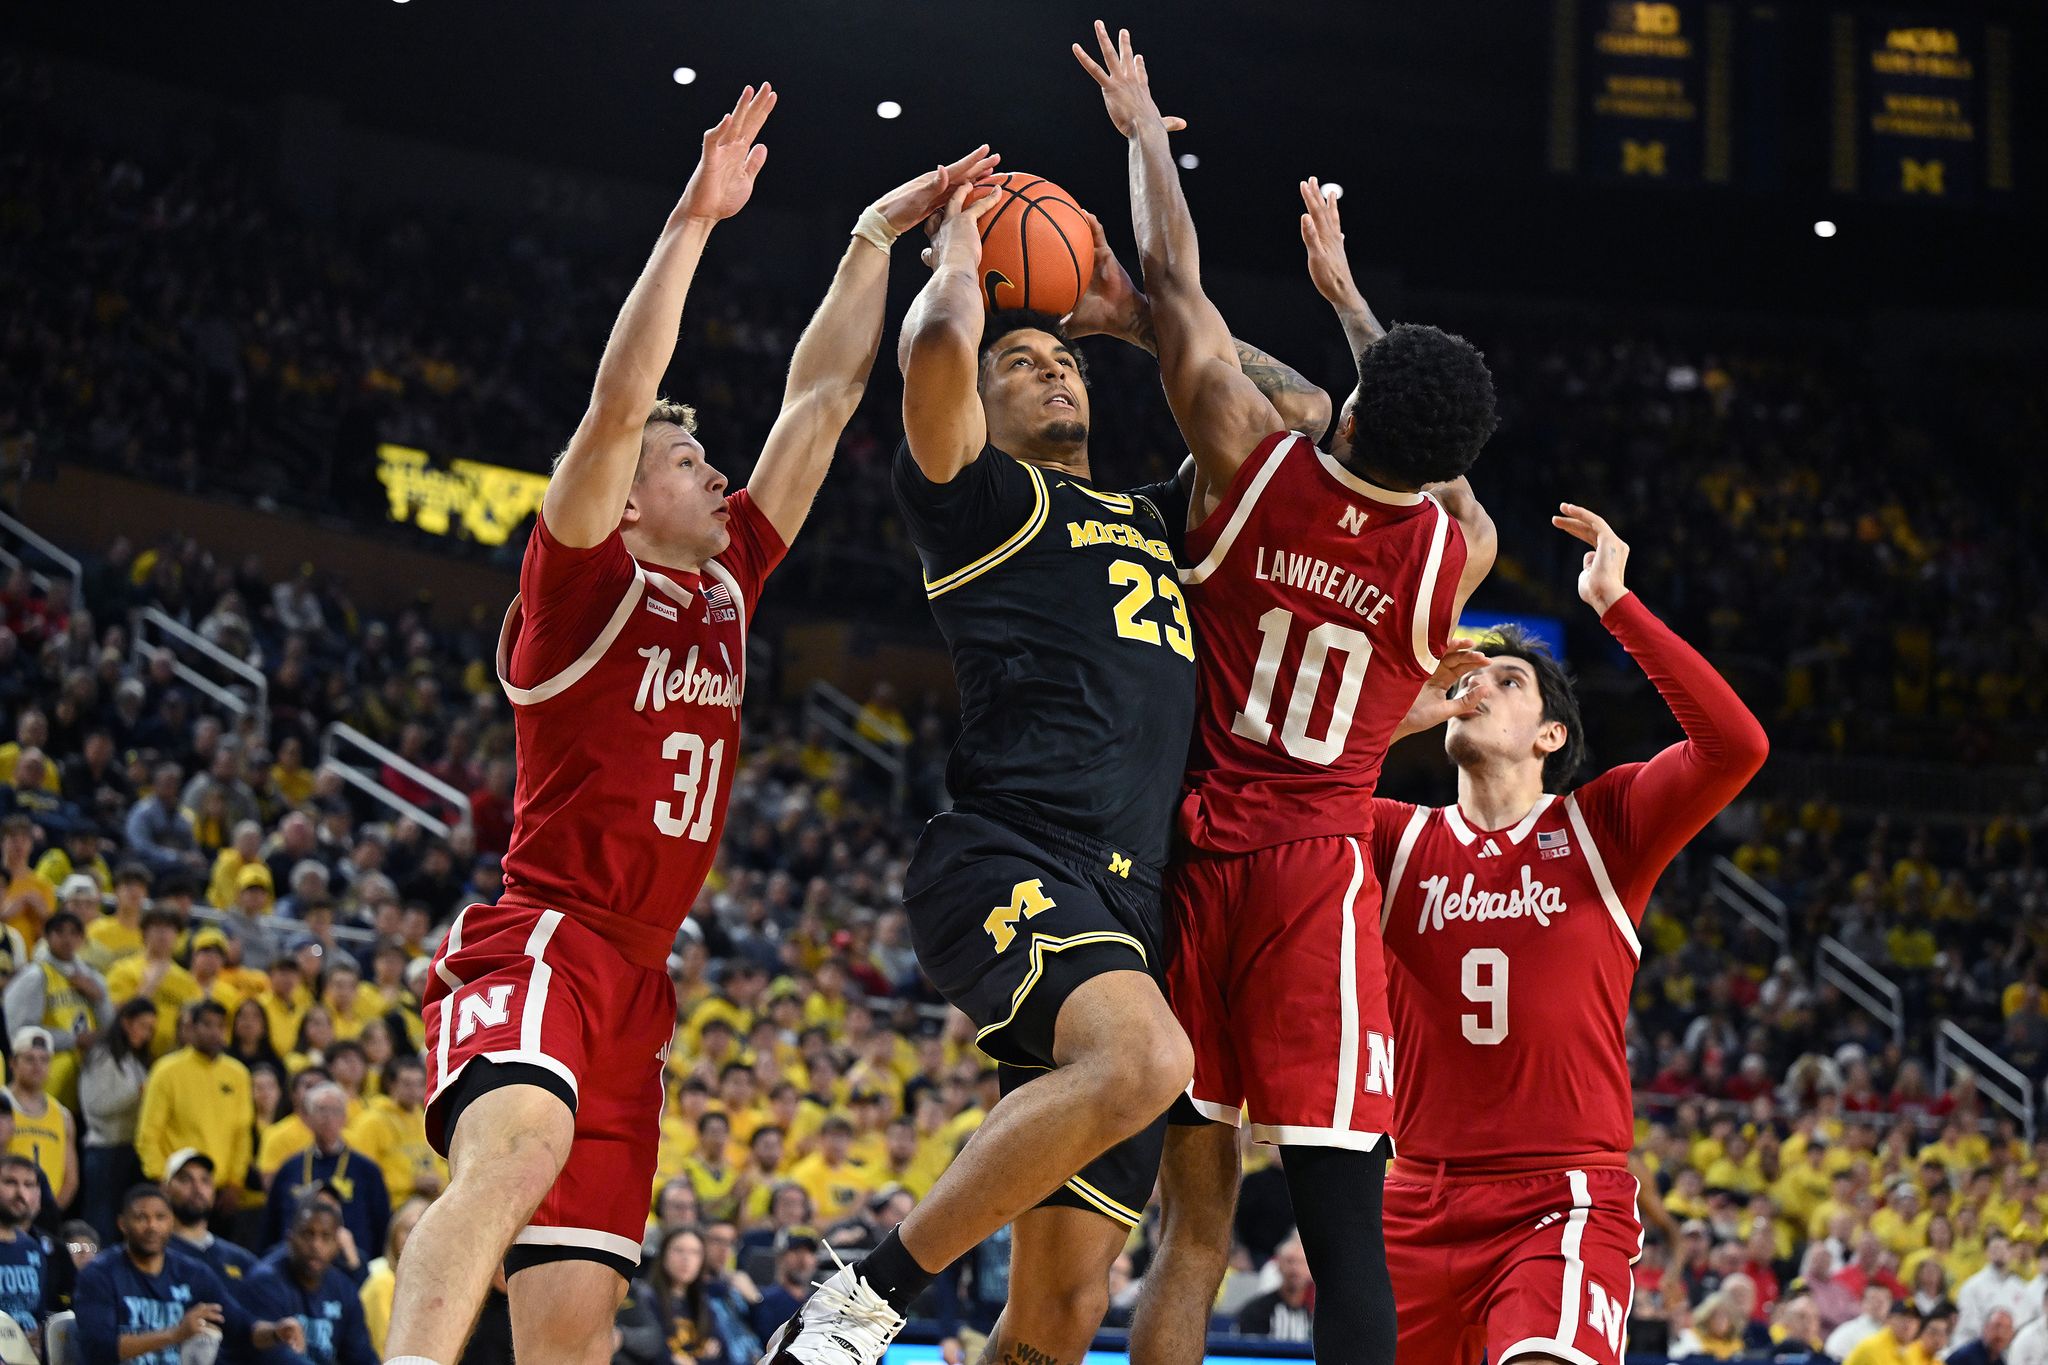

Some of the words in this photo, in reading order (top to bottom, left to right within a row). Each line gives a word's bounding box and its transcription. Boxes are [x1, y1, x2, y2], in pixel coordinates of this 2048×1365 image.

[1337, 504, 1369, 536] N
[648, 601, 677, 618] GRADUATE
[1108, 558, 1196, 663] 23
[1255, 546, 1395, 626] LAWRENCE
[1230, 606, 1374, 767] 10
[653, 731, 725, 843] 31
[1107, 851, 1133, 879] M
[1417, 864, 1568, 935] Nebraska
[983, 878, 1057, 955] M
[456, 984, 516, 1047] N
[1461, 947, 1510, 1046] 9
[1364, 1030, 1395, 1099] N
[1587, 1279, 1624, 1357] N
